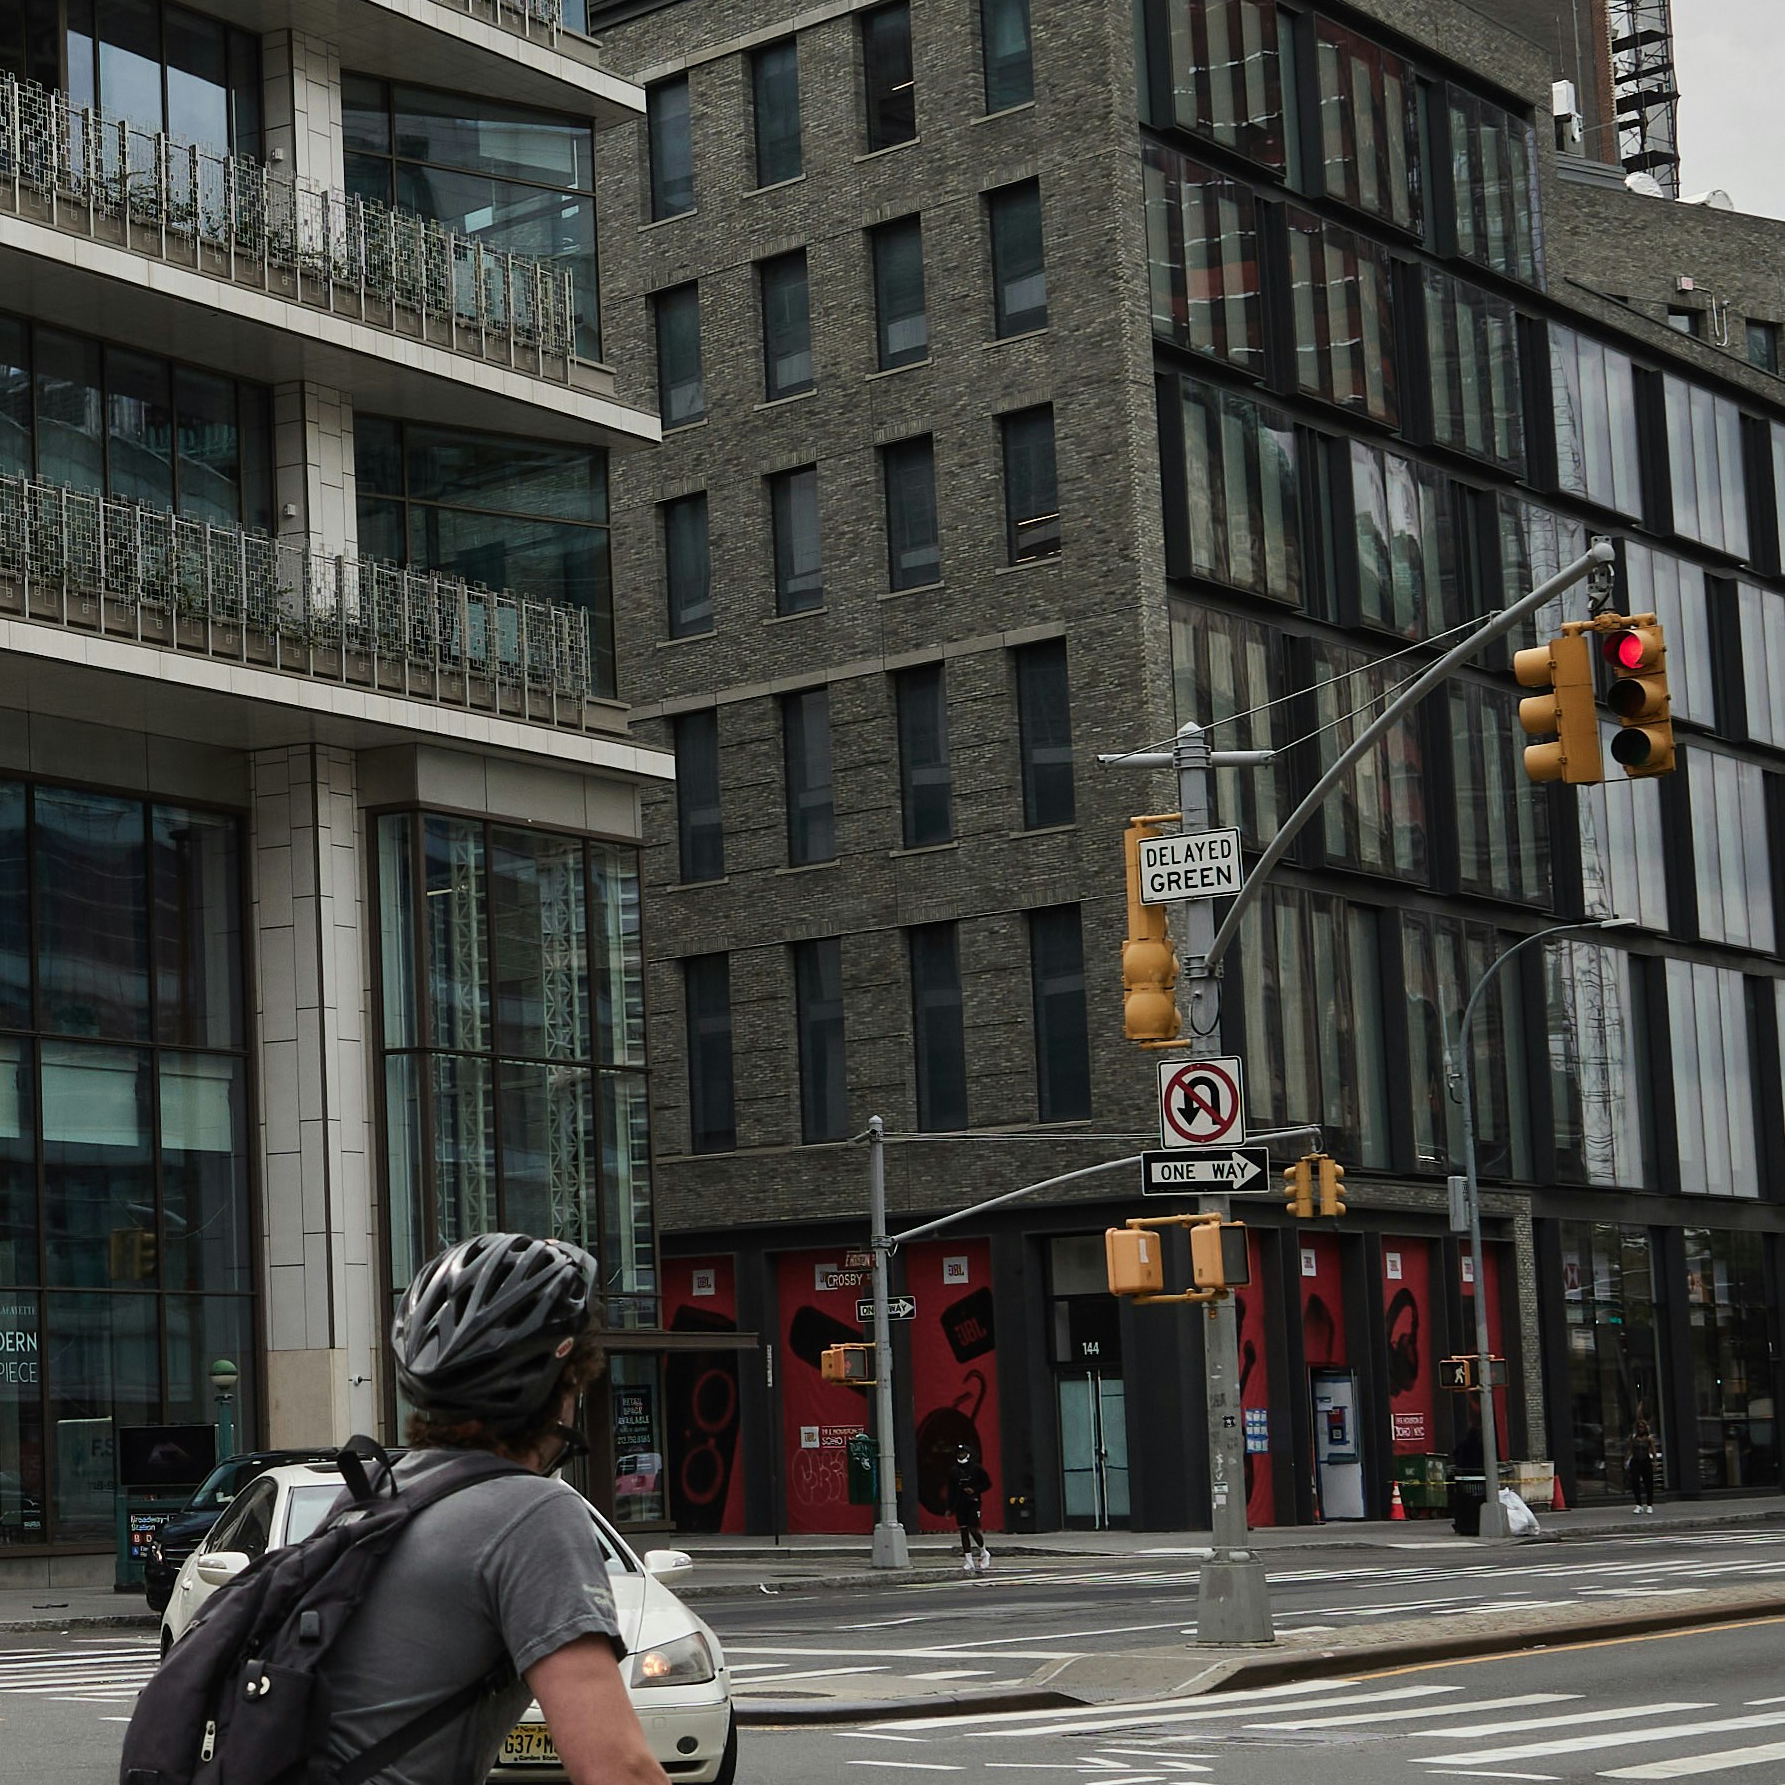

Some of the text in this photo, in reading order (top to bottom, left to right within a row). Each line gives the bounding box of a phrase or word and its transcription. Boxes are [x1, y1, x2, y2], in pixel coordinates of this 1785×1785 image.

[1146, 839, 1232, 868] DELAYED
[1150, 865, 1232, 893] GREEN
[1161, 1163, 1249, 1181] ONE WAY
[948, 1264, 964, 1276] JBL
[827, 1273, 863, 1287] CROSBY
[889, 1304, 907, 1313] WAY
[954, 1317, 988, 1347] JBL
[1082, 1341, 1100, 1355] 144
[505, 1734, 534, 1754] G37
